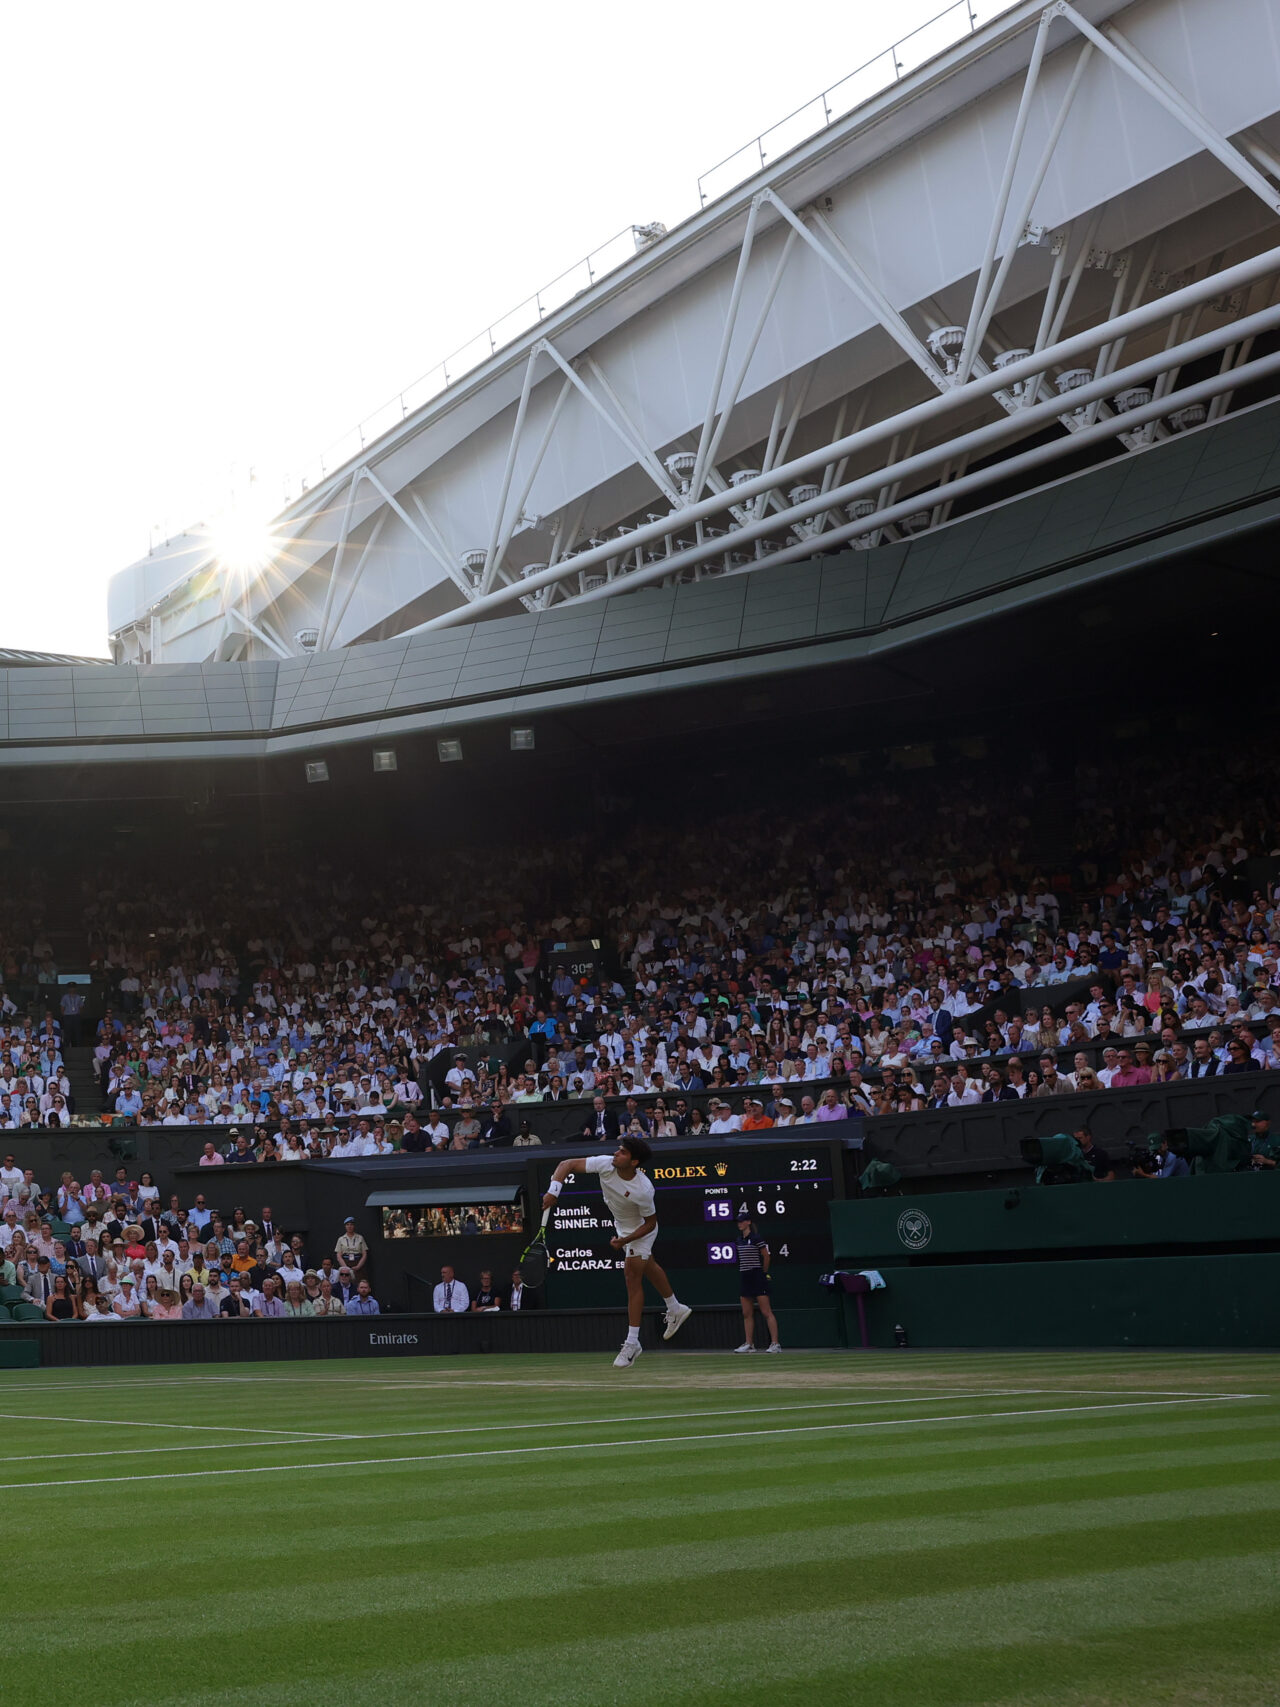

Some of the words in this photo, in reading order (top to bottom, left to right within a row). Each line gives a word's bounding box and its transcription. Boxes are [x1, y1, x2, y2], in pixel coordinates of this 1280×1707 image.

[571, 963, 586, 975] 30
[790, 1159, 818, 1171] 2:22
[653, 1165, 708, 1179] ROLEX
[704, 1187, 729, 1195] POINTS
[553, 1205, 591, 1217] Jannik
[707, 1202, 730, 1217] 15
[739, 1202, 749, 1214] 4
[756, 1200, 768, 1215] 6
[775, 1199, 786, 1214] 6
[553, 1218, 599, 1230] SINNER
[601, 1219, 613, 1228] ITA
[555, 1248, 593, 1258] Carlos
[710, 1245, 733, 1260] 30
[778, 1243, 790, 1257] 4
[556, 1259, 613, 1272] ALCARAZ
[615, 1260, 625, 1269] ES
[369, 1332, 418, 1345] Emirates
